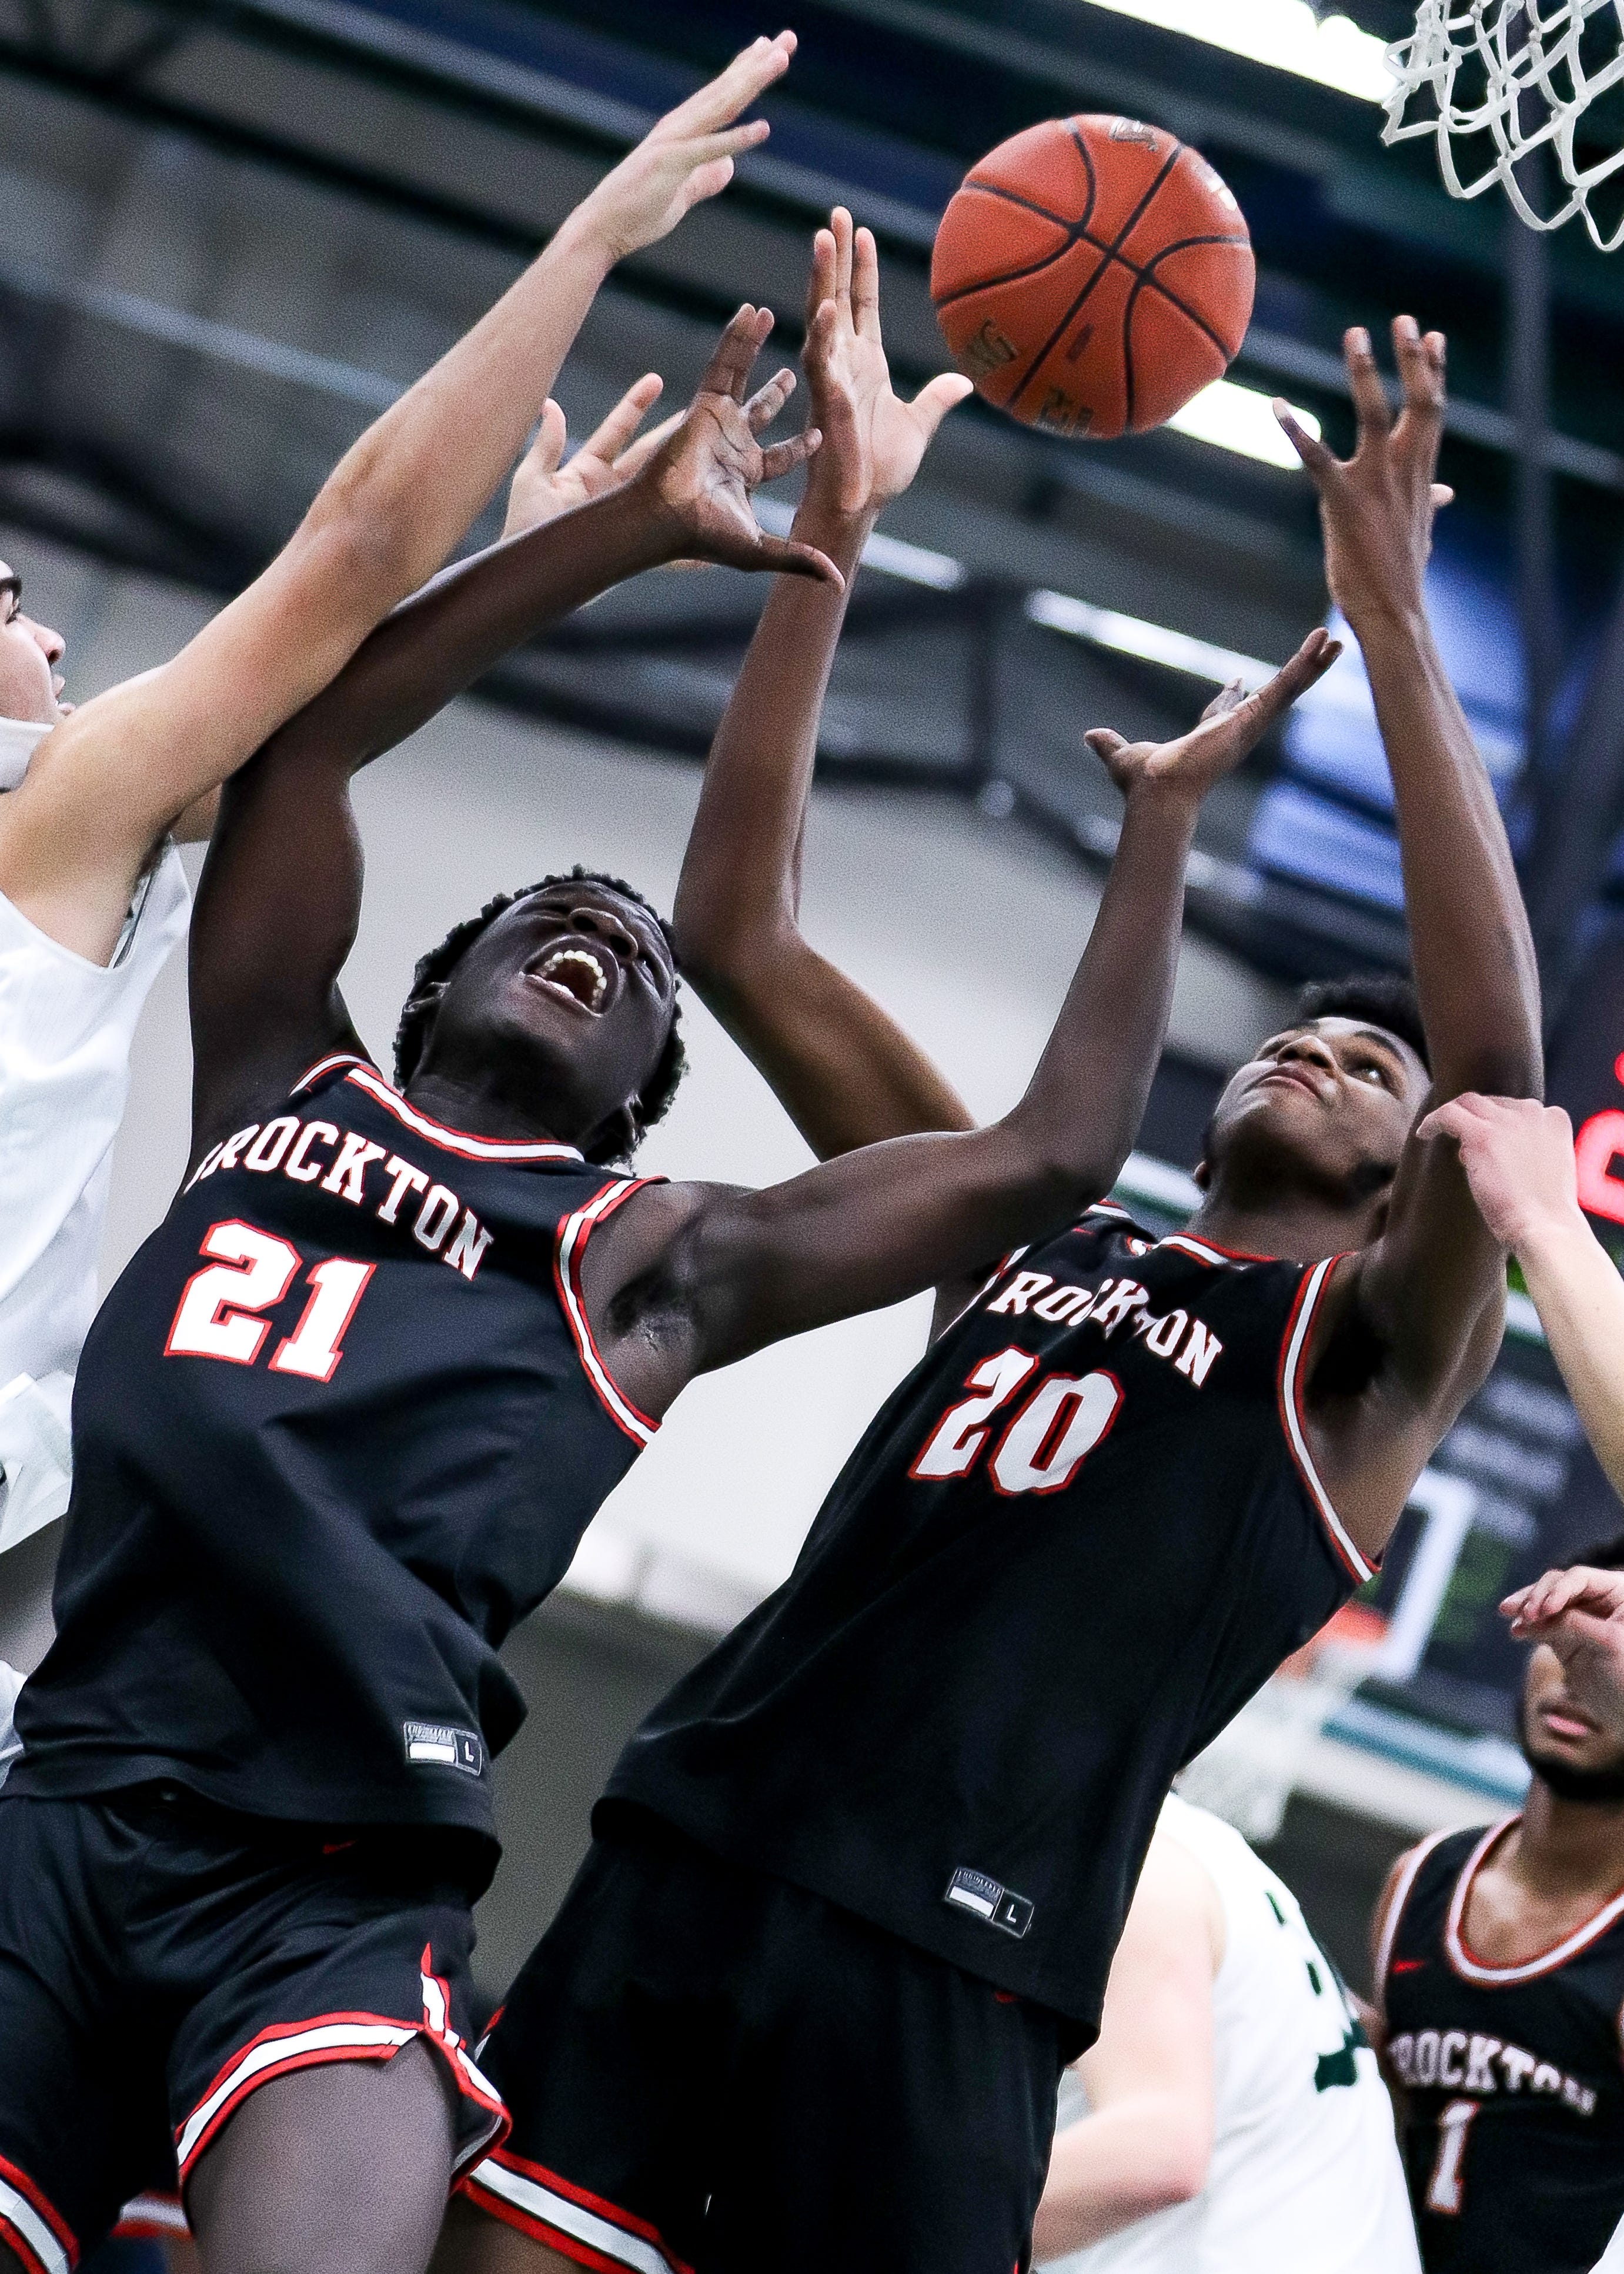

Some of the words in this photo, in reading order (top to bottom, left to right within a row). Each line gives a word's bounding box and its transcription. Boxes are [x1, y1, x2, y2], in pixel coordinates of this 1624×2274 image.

[183, 1116, 494, 1281] ROCKTON
[164, 1218, 376, 1383] 21
[985, 1271, 1224, 1388] ROKON
[909, 1345, 1124, 1496] 20
[465, 1741, 474, 1762] L
[1006, 1904, 1017, 1924] L
[1425, 2098, 1481, 2216] 1
